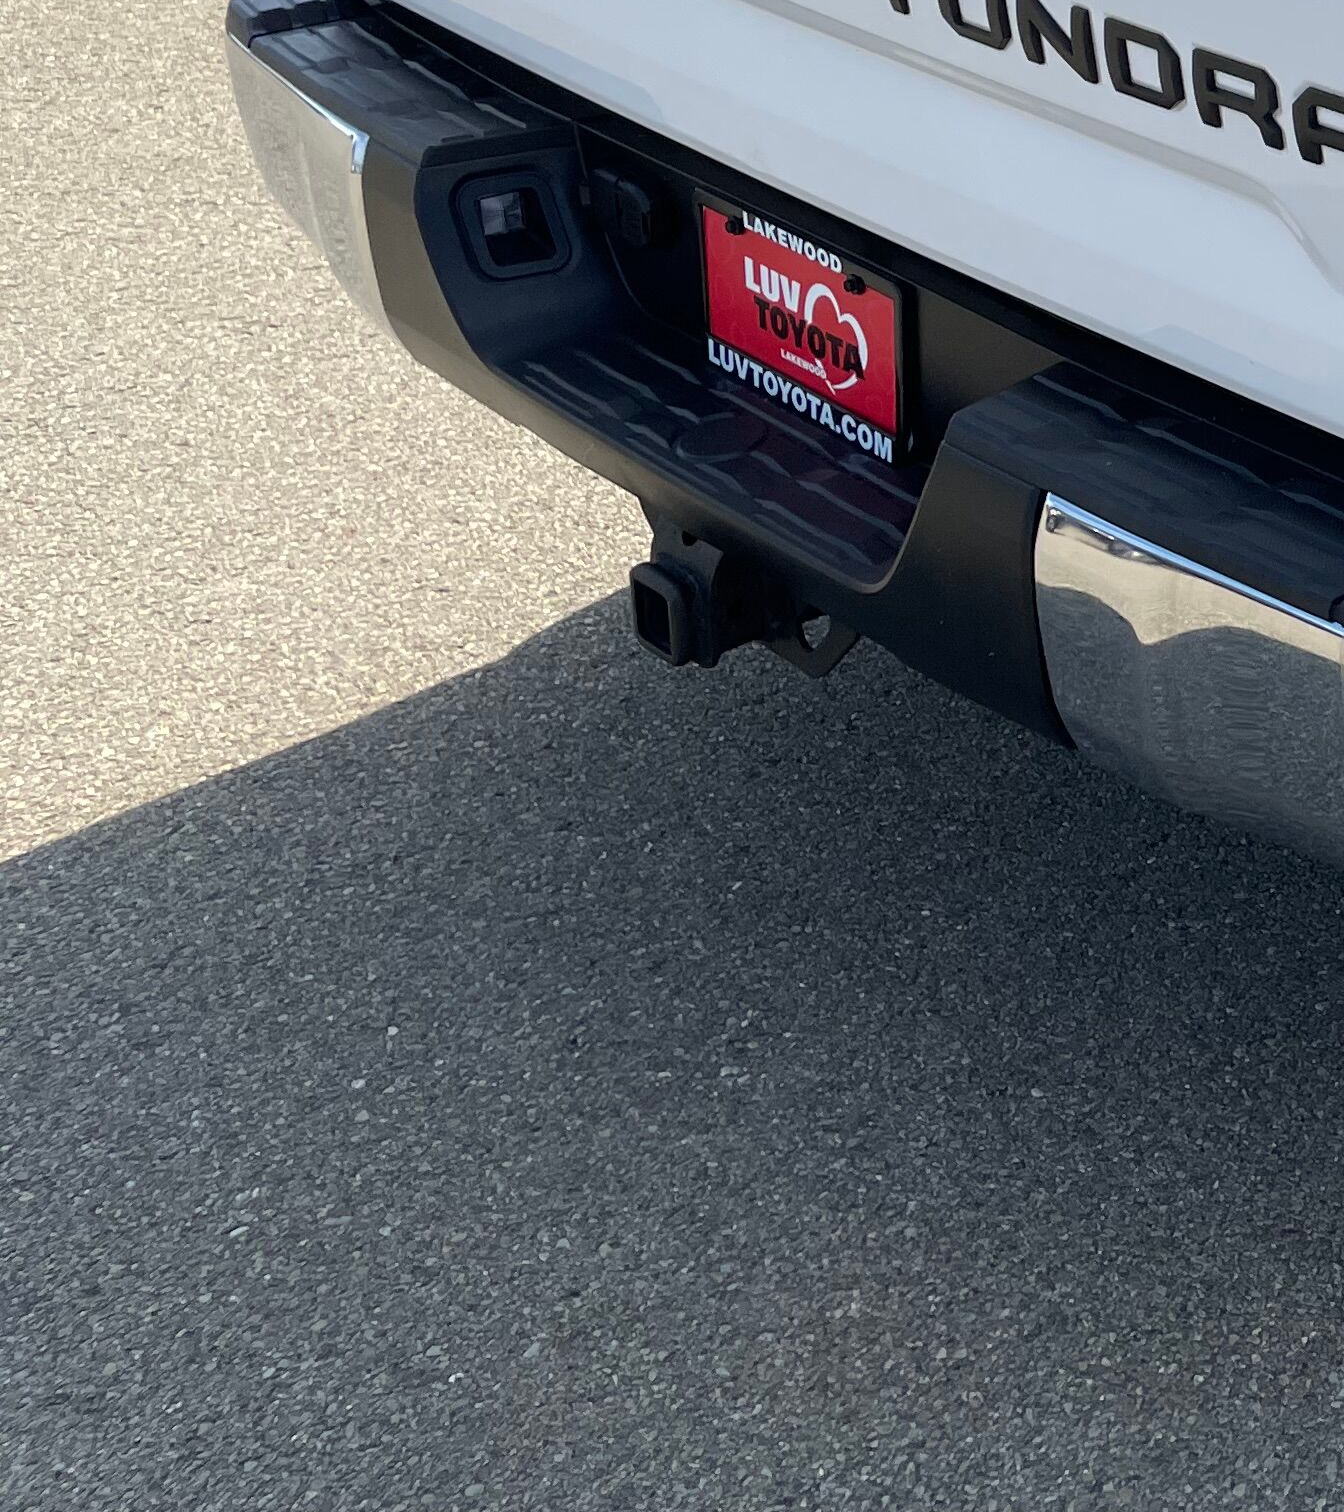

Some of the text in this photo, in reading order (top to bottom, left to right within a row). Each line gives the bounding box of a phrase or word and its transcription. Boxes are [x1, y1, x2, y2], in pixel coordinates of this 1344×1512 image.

[742, 210, 843, 274] LAKEWOOD
[744, 256, 800, 313] LUV
[754, 295, 865, 380] TOYOTA
[780, 348, 827, 380] LAKEWOOD
[707, 338, 893, 464] LUVTOYOTA.COM
